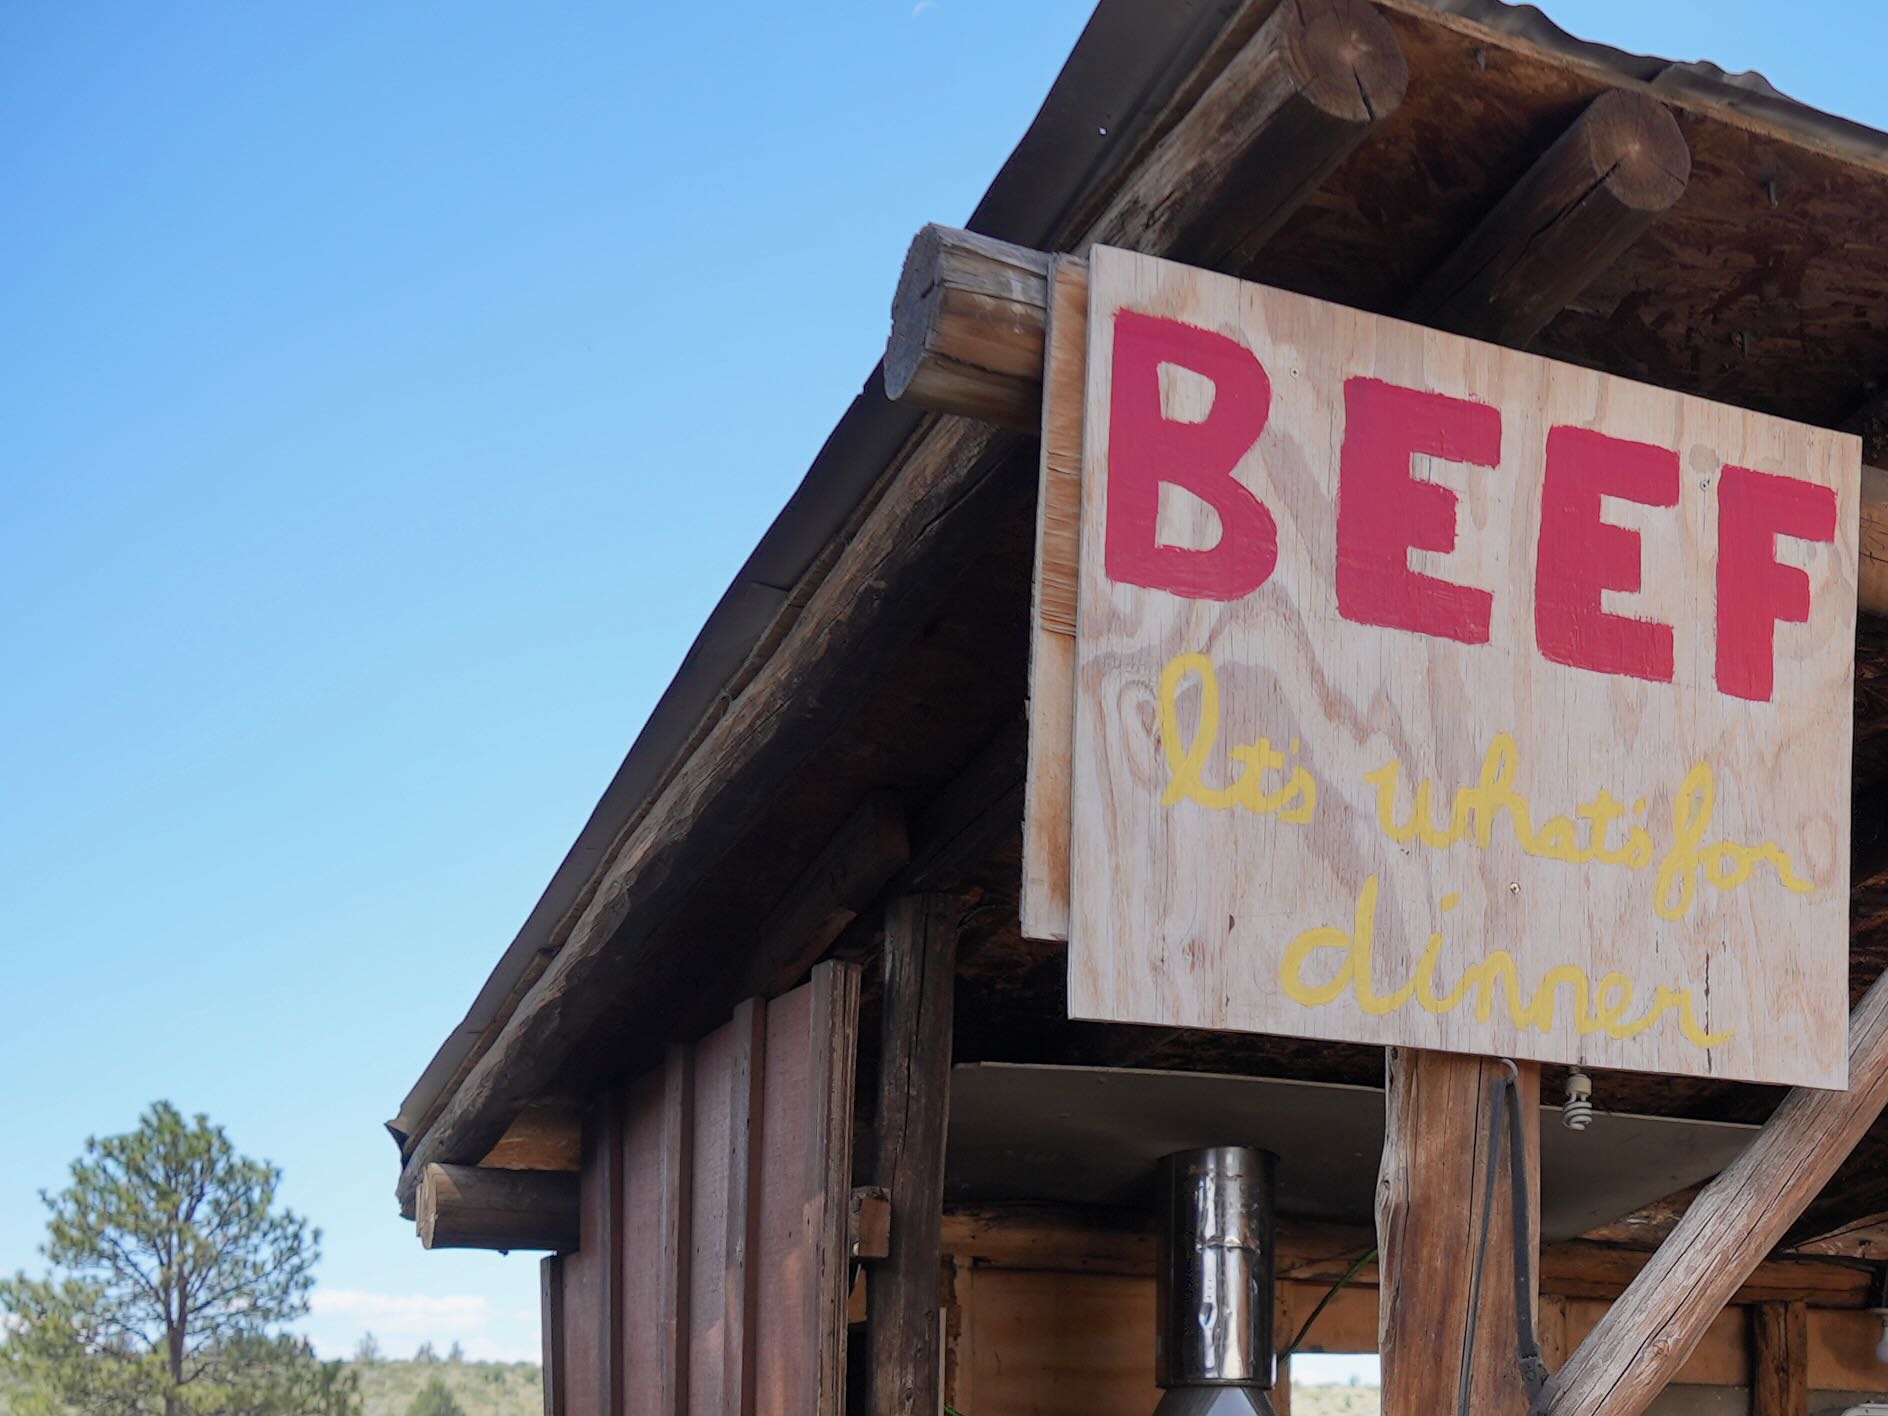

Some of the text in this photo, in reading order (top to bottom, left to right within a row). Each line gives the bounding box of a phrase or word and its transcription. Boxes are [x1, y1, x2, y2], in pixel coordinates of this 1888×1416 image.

[1104, 307, 1838, 702] BEEF
[1654, 760, 1815, 921] for
[1280, 875, 1734, 1047] dinner
